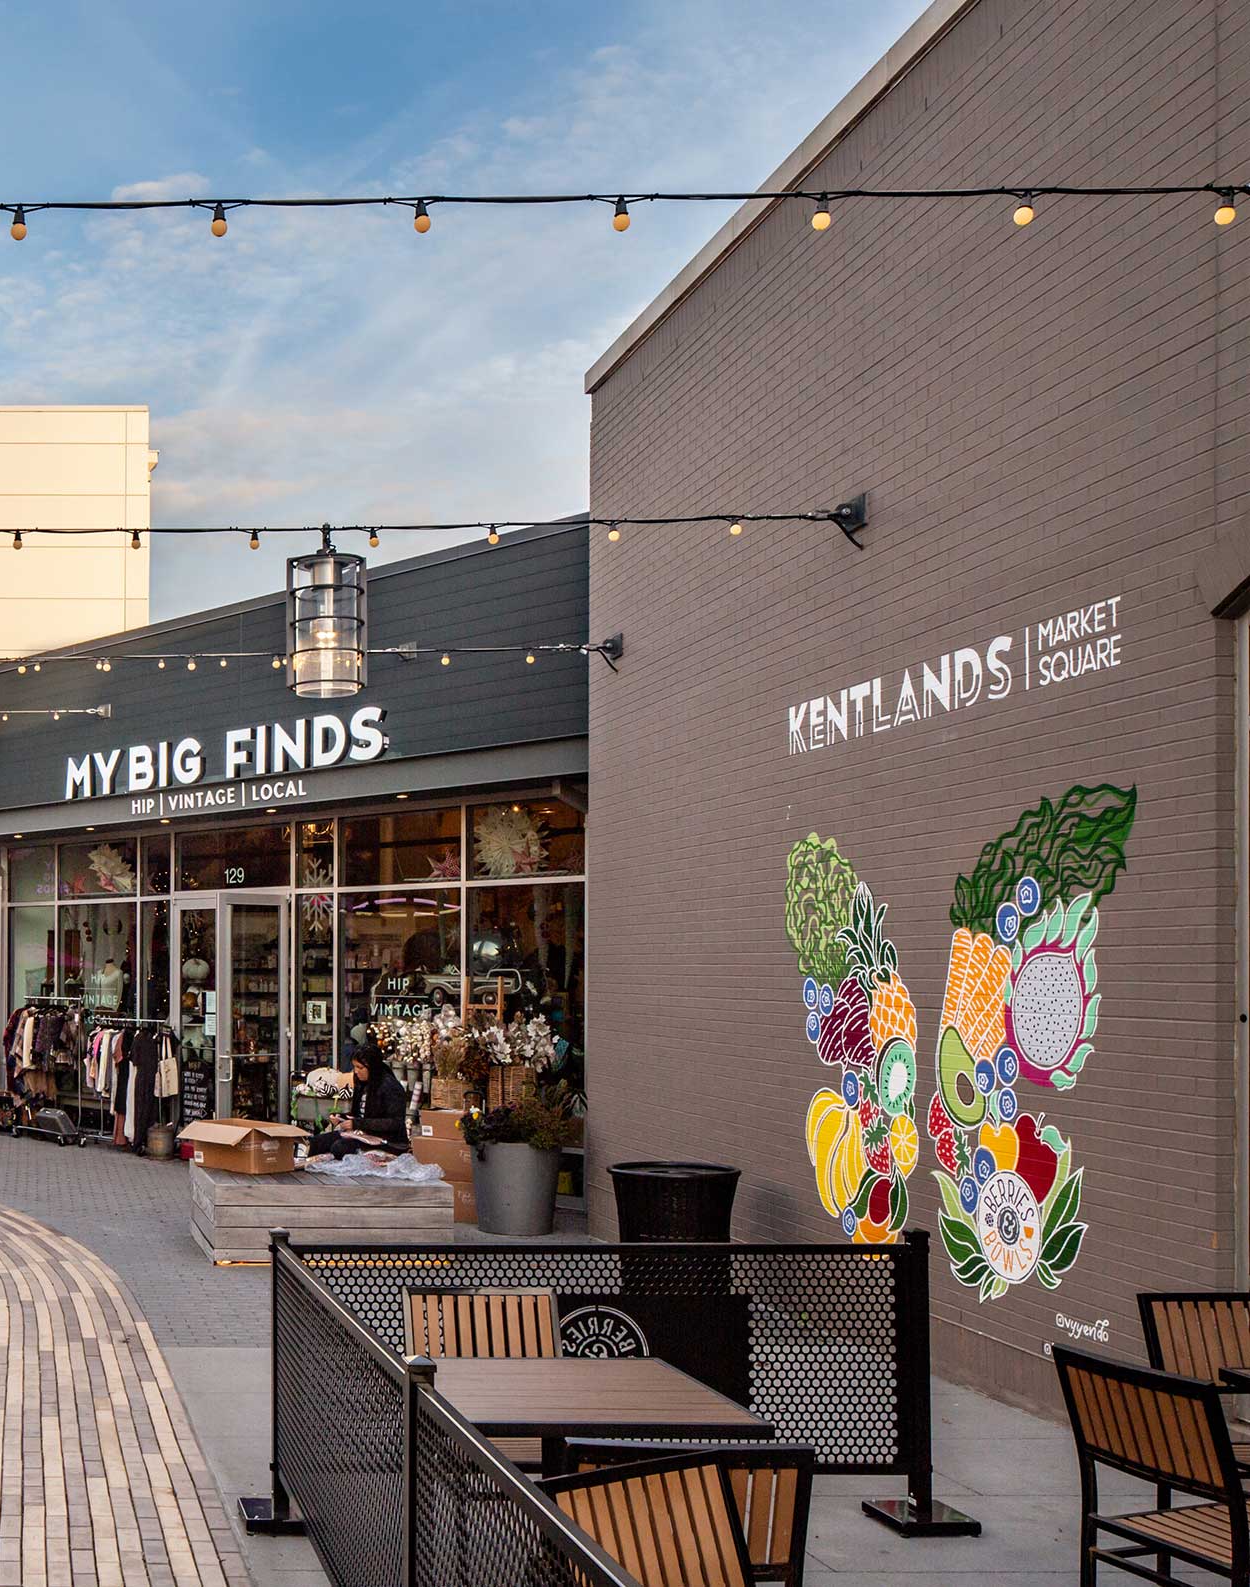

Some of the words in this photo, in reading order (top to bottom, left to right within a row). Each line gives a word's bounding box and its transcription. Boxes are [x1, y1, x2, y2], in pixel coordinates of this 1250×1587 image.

[1038, 596, 1121, 651] MARKET
[1038, 634, 1122, 686] SQUARE
[788, 636, 1013, 756] KENTLANDS
[225, 706, 387, 779] FINDS
[131, 798, 155, 815] HIP
[168, 787, 235, 811] VINTAGE
[252, 780, 307, 801] LOCAL
[224, 867, 244, 884] 129
[387, 978, 410, 990] HIP
[983, 1179, 1035, 1222] BERRIES
[983, 1230, 1033, 1273] BOWLS
